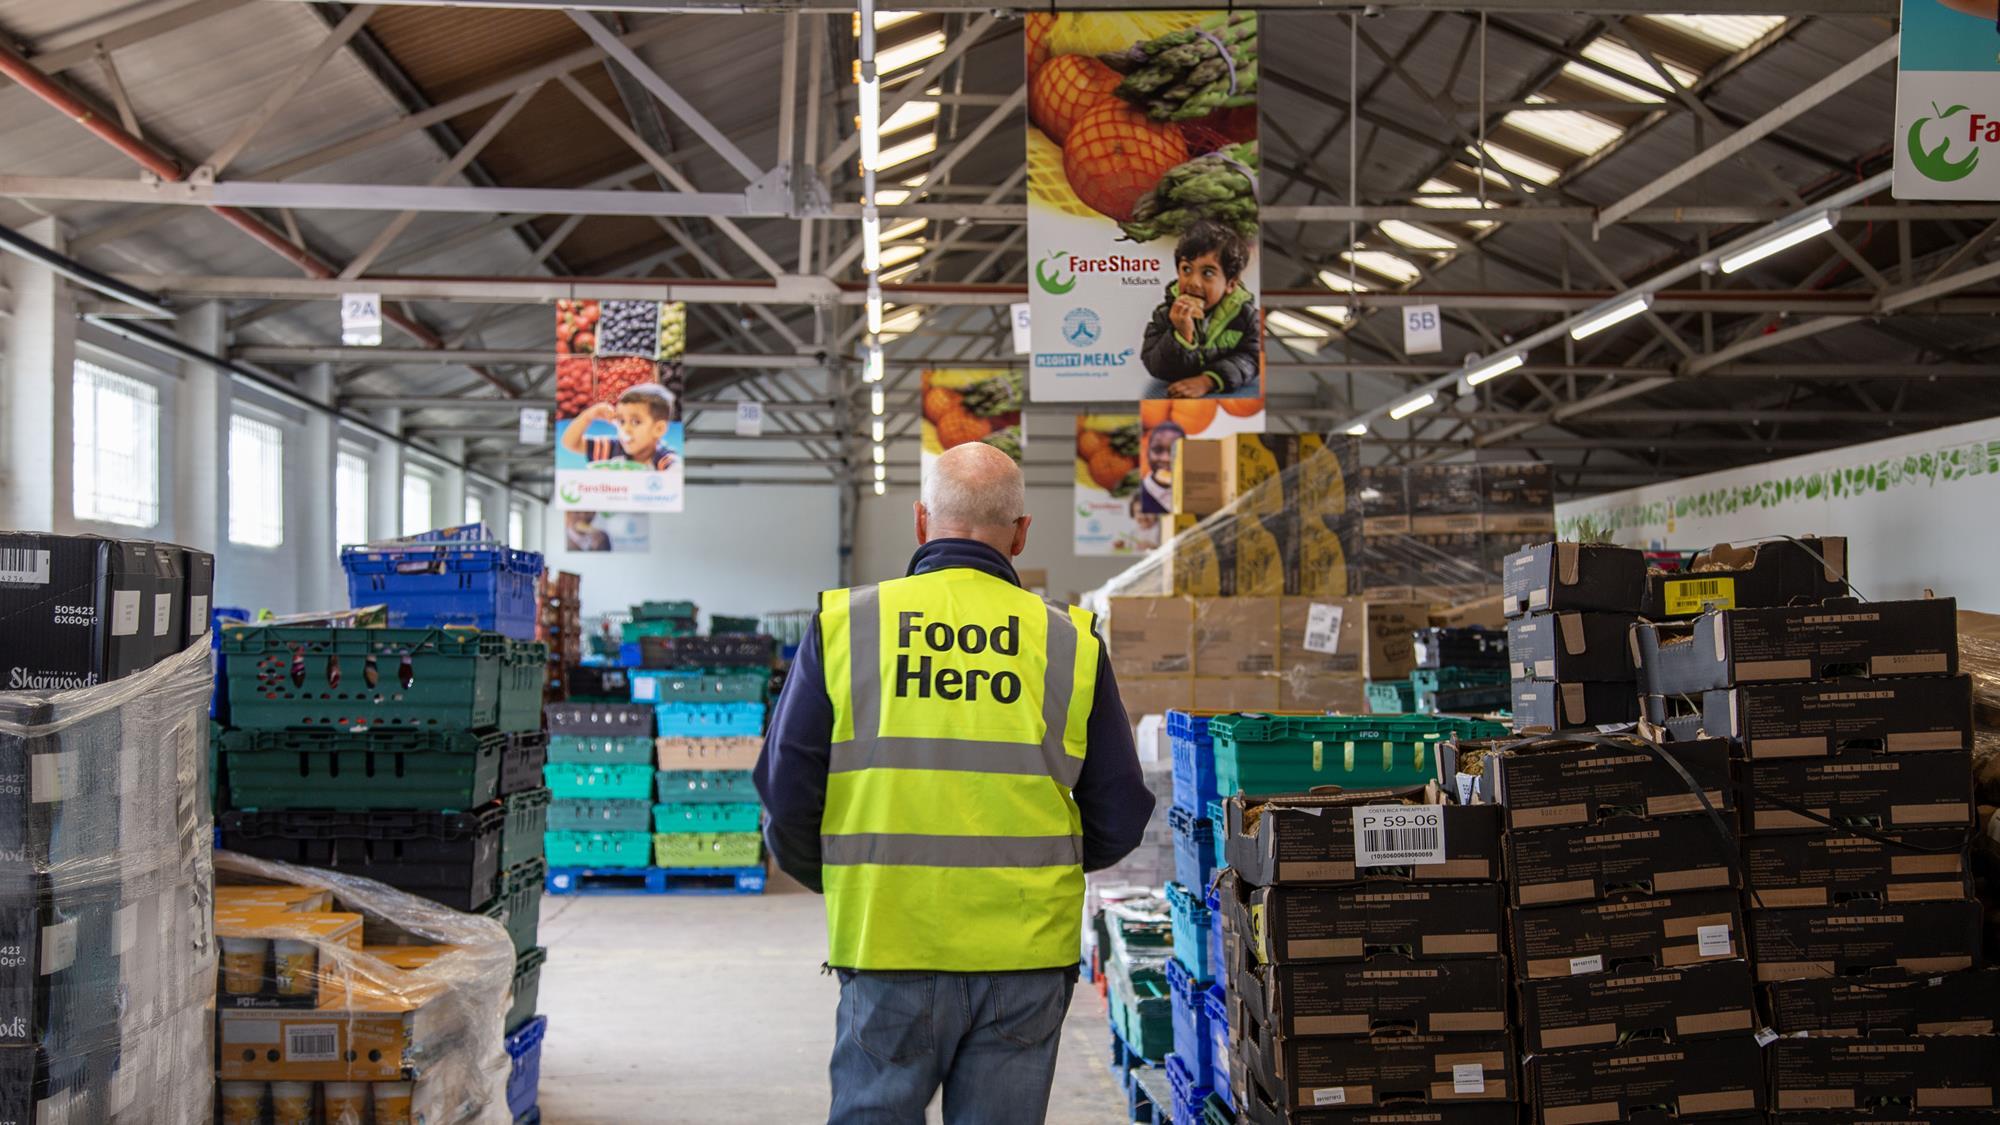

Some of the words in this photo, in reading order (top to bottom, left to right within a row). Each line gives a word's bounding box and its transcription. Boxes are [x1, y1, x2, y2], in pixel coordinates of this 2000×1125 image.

[1969, 114, 2000, 143] Fa
[1069, 255, 1161, 273] FareShare
[1121, 277, 1161, 286] Midlands
[350, 301, 376, 318] 2A
[1409, 312, 1435, 331] 5B
[1083, 353, 1127, 367] MEALS
[54, 605, 95, 616] 505423
[898, 611, 1020, 657] Food
[895, 654, 1022, 705] Hero
[1363, 817, 1376, 828] P
[1384, 814, 1438, 828] 59-06
